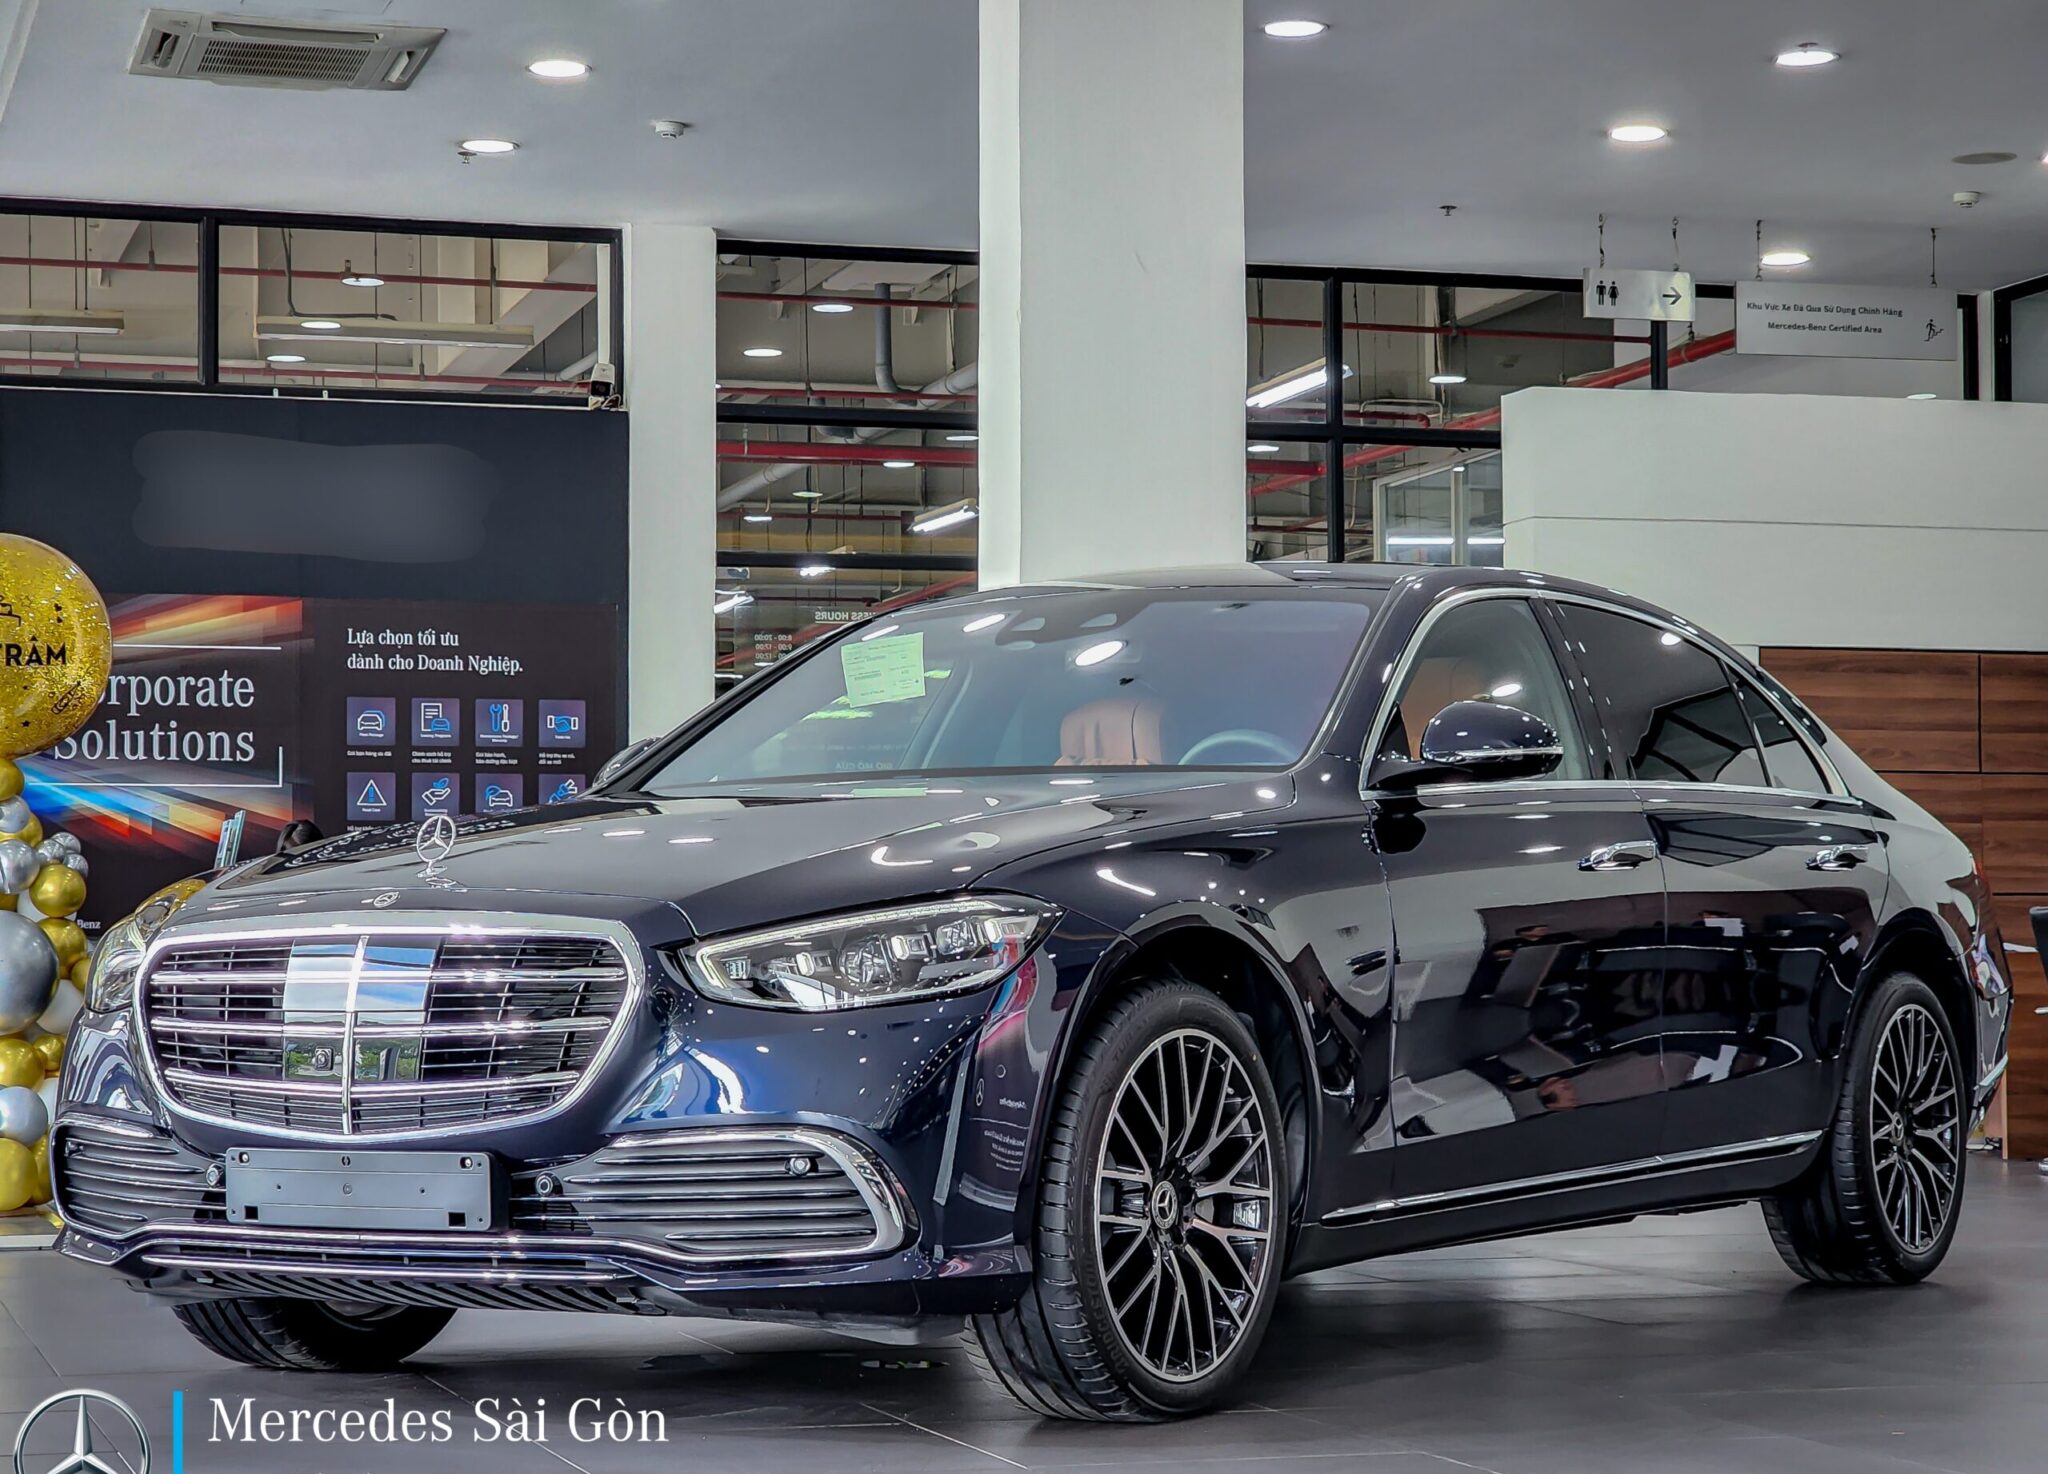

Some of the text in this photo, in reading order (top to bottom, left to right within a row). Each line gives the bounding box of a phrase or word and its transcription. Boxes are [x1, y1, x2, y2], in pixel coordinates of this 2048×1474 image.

[1747, 302, 1762, 310] Khu
[1767, 321, 1882, 334] Mercedes-Benz Certified Area
[347, 628, 459, 649] Lựa chọn tối ưu
[0, 635, 67, 666] RÂM
[347, 653, 523, 676] dành cho Doanh Nghiệp.
[98, 669, 255, 716] rporate
